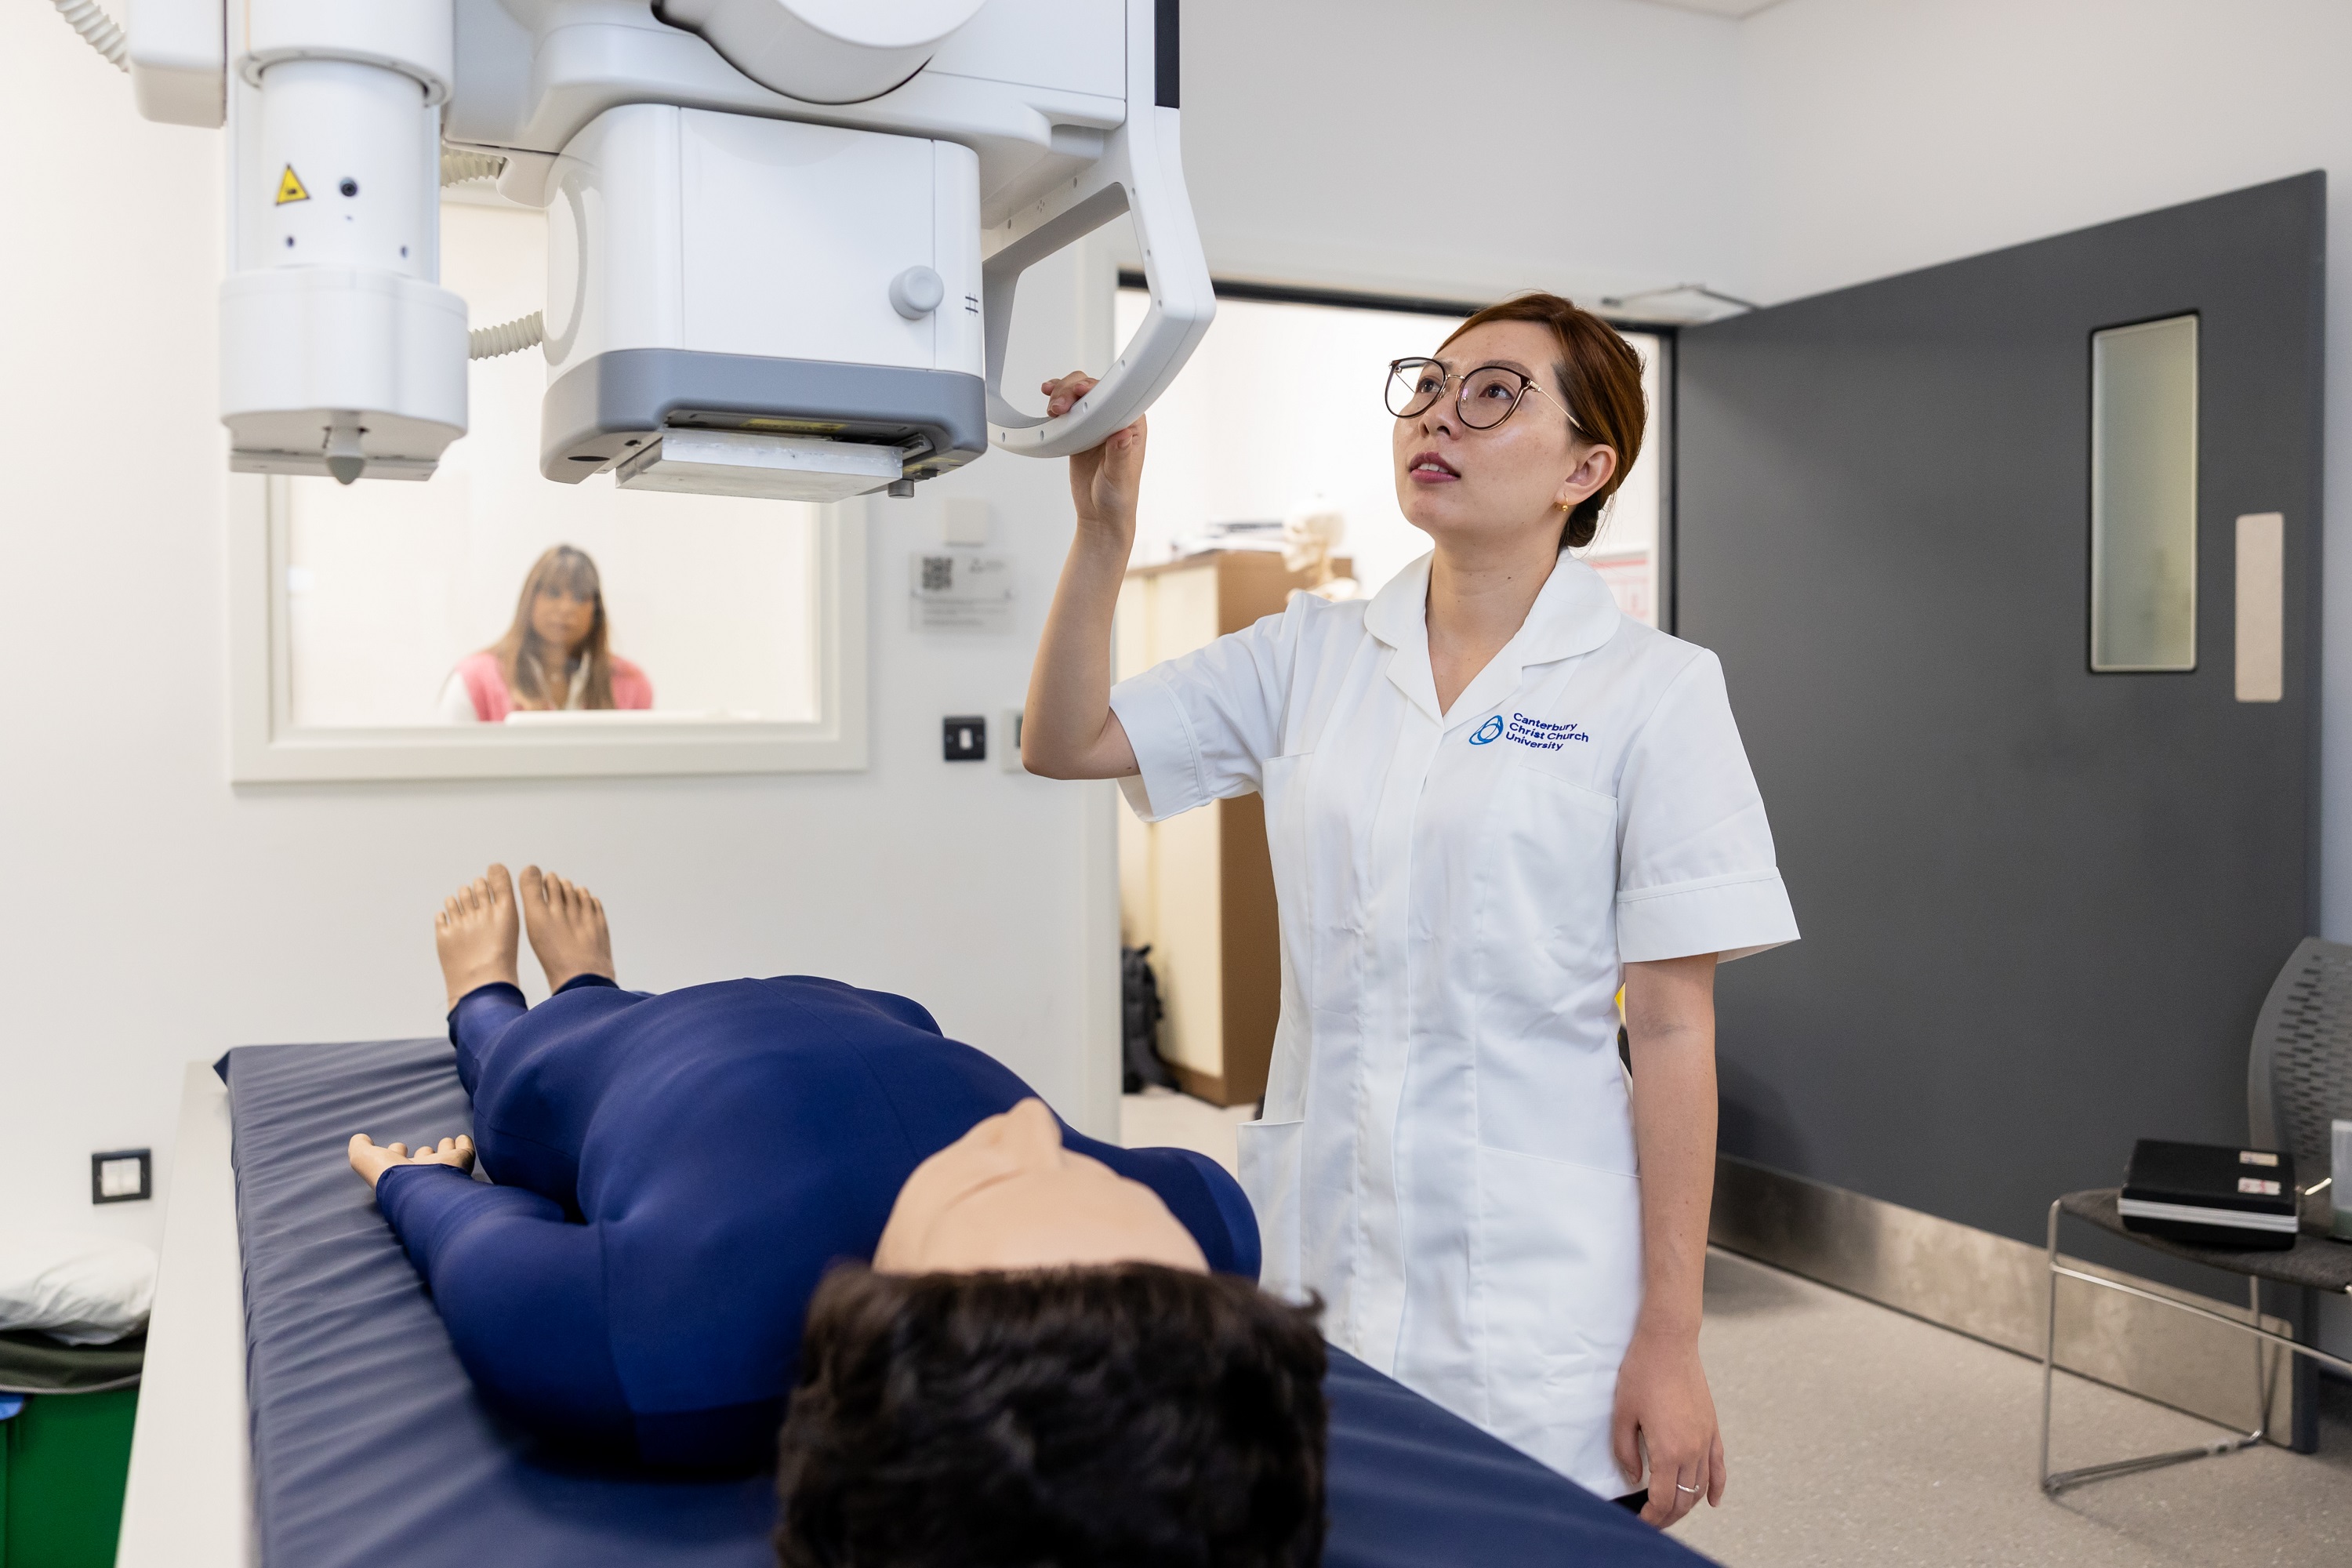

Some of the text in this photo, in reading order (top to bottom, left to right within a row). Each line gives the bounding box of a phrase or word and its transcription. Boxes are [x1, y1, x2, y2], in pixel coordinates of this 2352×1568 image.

[1509, 722, 1589, 742] Christ Church
[1513, 713, 1577, 731] Canterbury
[1505, 731, 1564, 751] University
